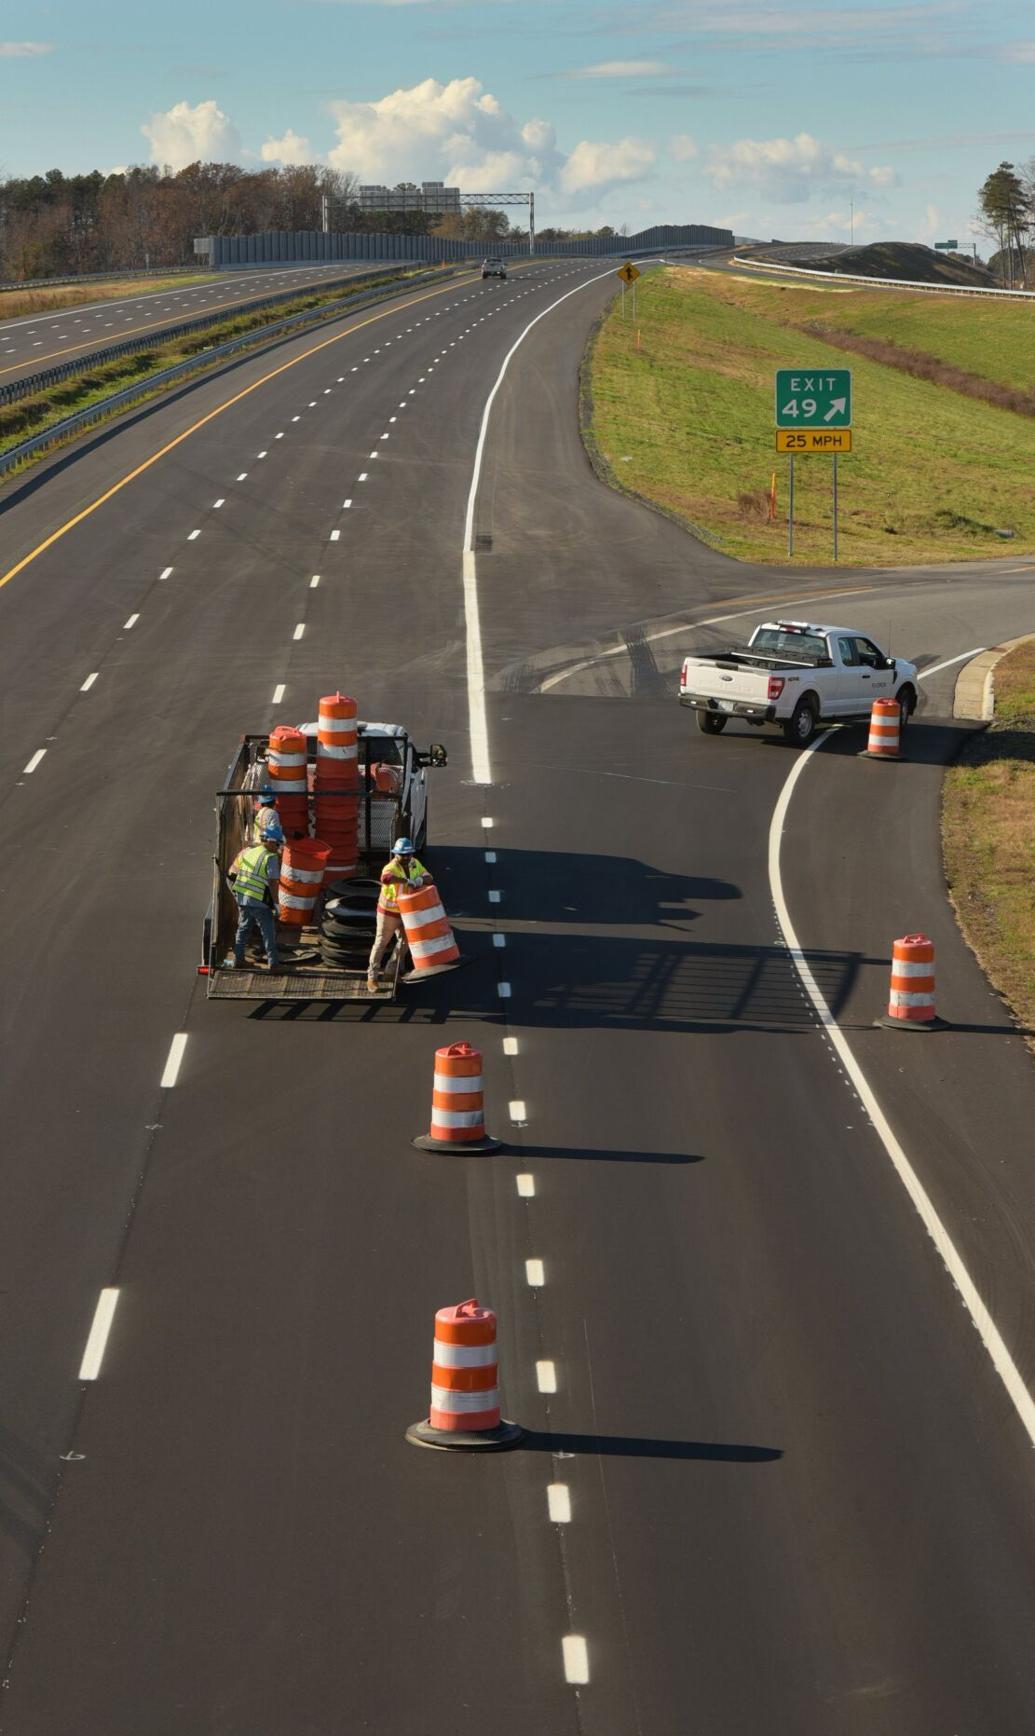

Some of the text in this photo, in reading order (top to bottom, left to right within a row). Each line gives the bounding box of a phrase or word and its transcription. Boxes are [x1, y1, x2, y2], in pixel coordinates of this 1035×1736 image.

[791, 378, 836, 391] EXIT
[782, 399, 817, 418] 49
[786, 435, 842, 448] 25 MPH
